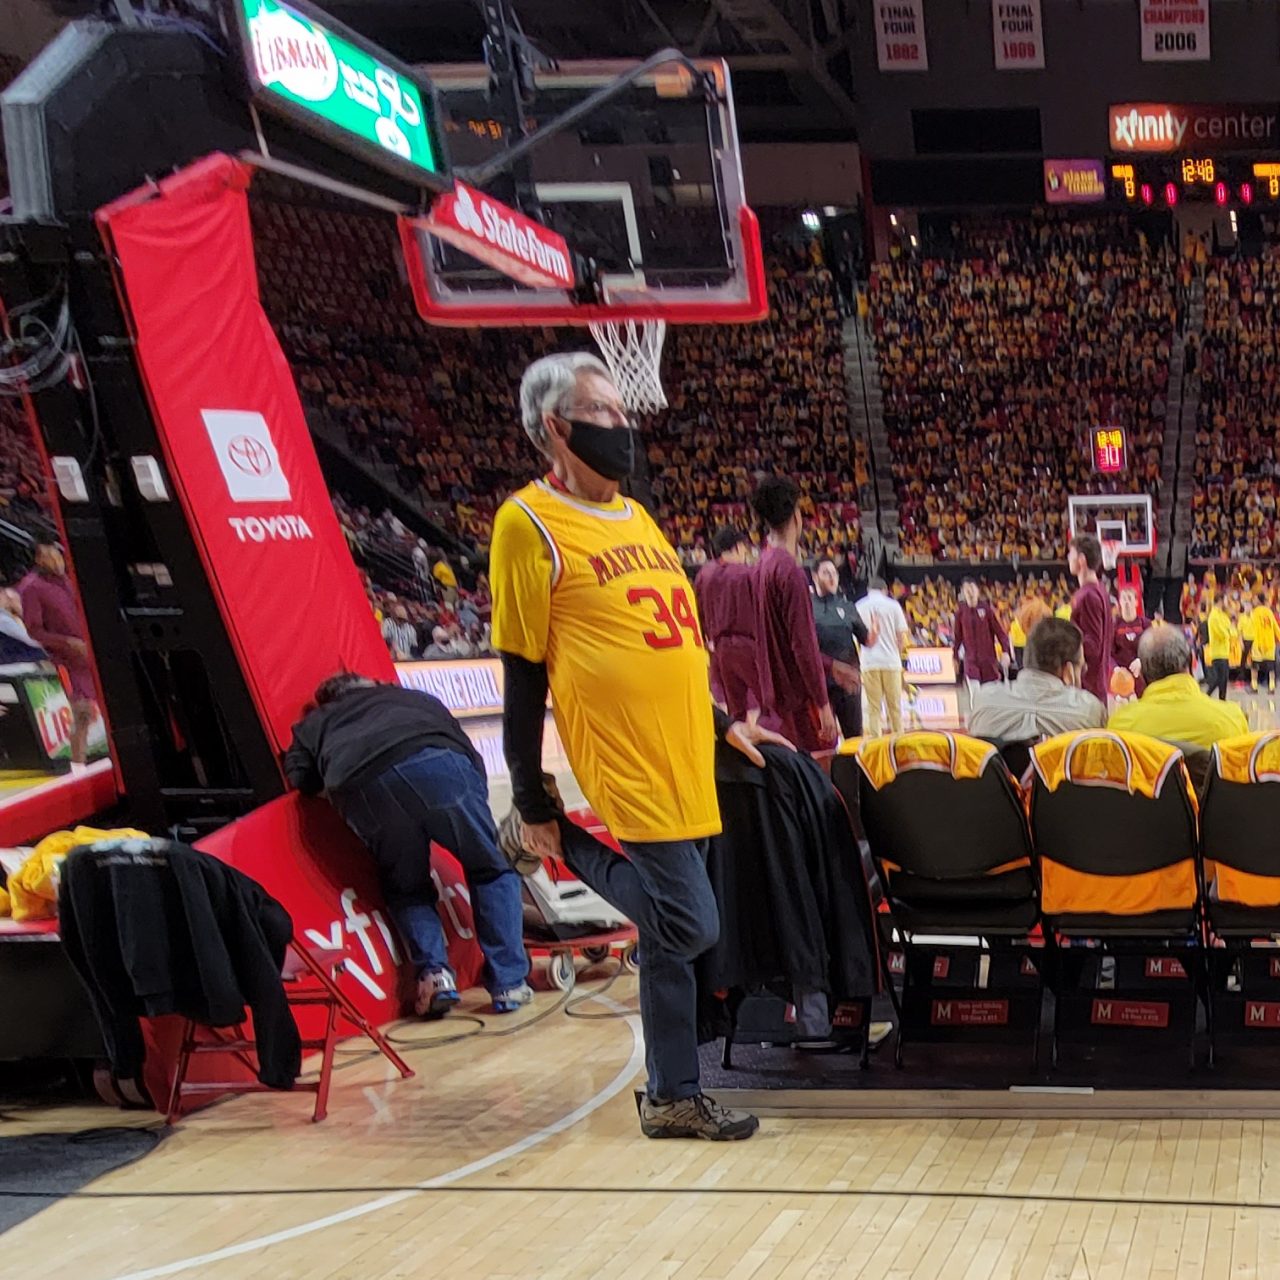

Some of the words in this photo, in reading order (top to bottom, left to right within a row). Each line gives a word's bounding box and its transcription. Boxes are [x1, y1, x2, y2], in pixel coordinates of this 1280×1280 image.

[881, 6, 916, 20] FINAL
[1000, 4, 1033, 17] FINAL
[884, 21, 915, 34] FOUR
[1002, 20, 1033, 33] FOUR
[1154, 31, 1197, 52] 2006
[1115, 108, 1188, 147] xfinity
[1194, 111, 1276, 138] center
[228, 515, 313, 542] TOYOTA
[587, 544, 686, 587] MARYLAN
[626, 586, 703, 650] 34
[1250, 1006, 1265, 1021] M
